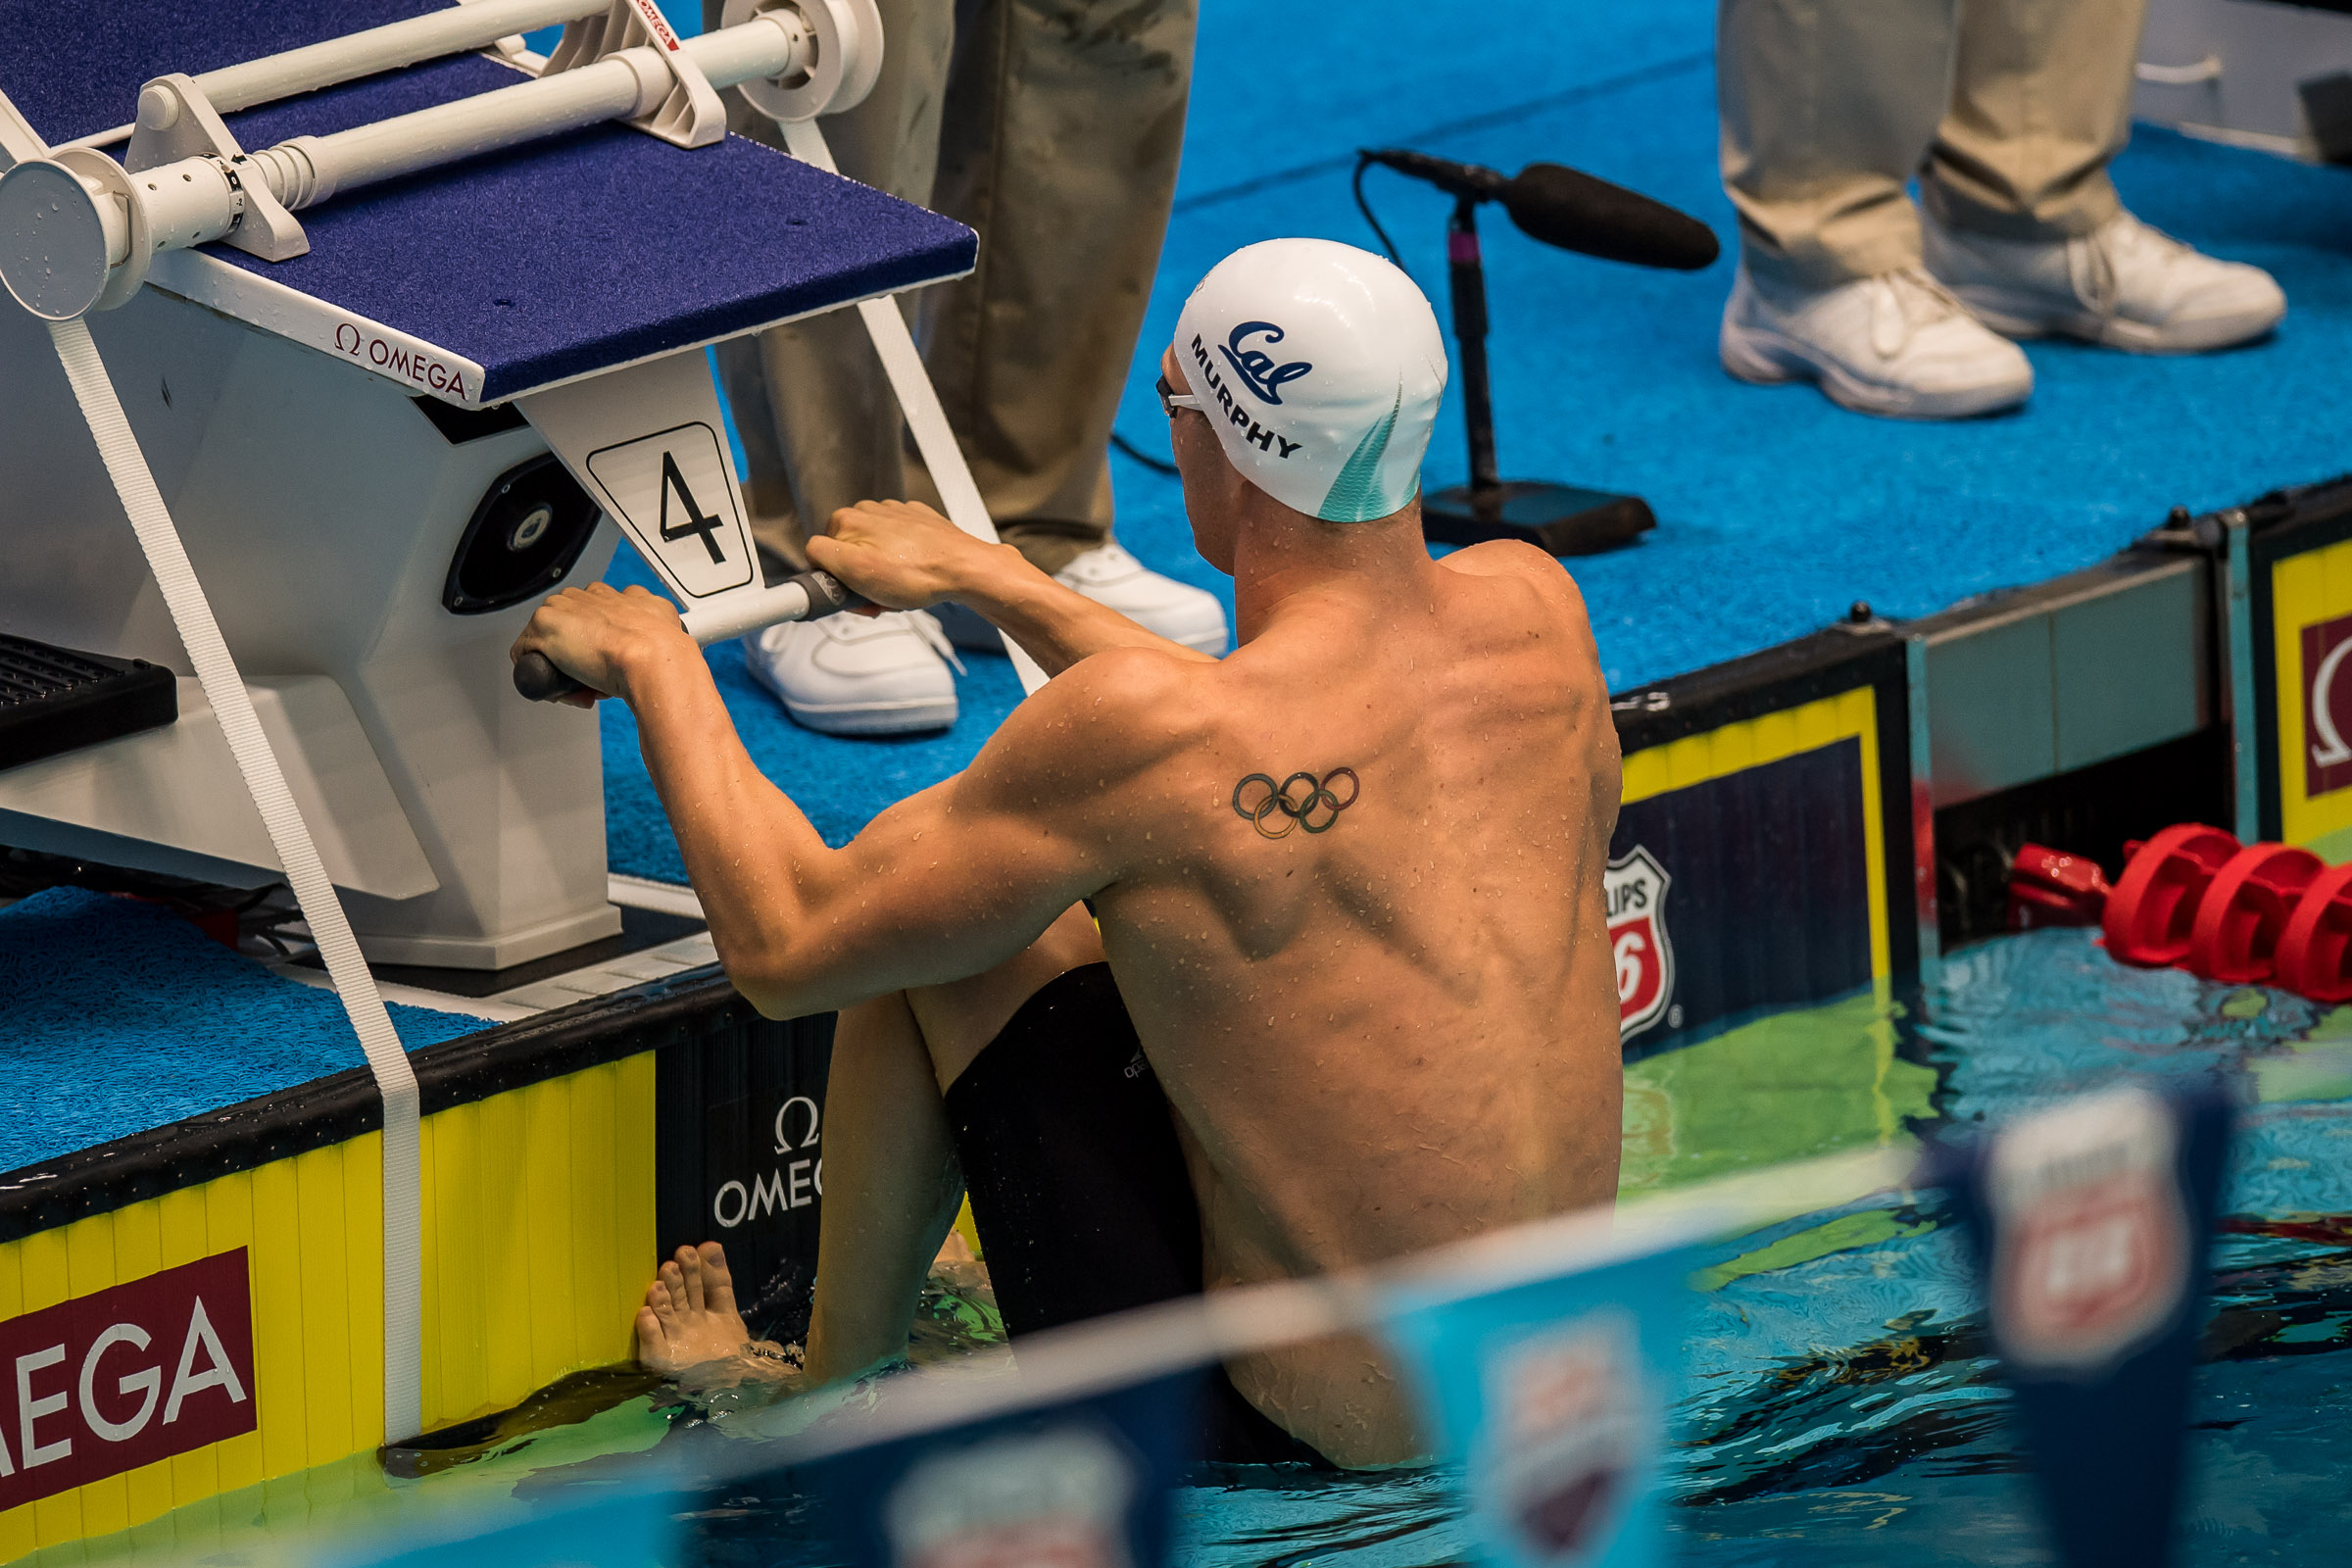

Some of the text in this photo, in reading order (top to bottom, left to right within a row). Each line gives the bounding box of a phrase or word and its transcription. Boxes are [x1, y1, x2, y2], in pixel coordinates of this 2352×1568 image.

[638, 0, 673, 45] OMEGA
[368, 338, 466, 401] OMEGA
[1191, 332, 1303, 460] MURPHY
[1217, 320, 1313, 406] Cal
[660, 450, 727, 564] 4
[713, 1158, 823, 1228] OME
[0, 1295, 247, 1477] EGA
